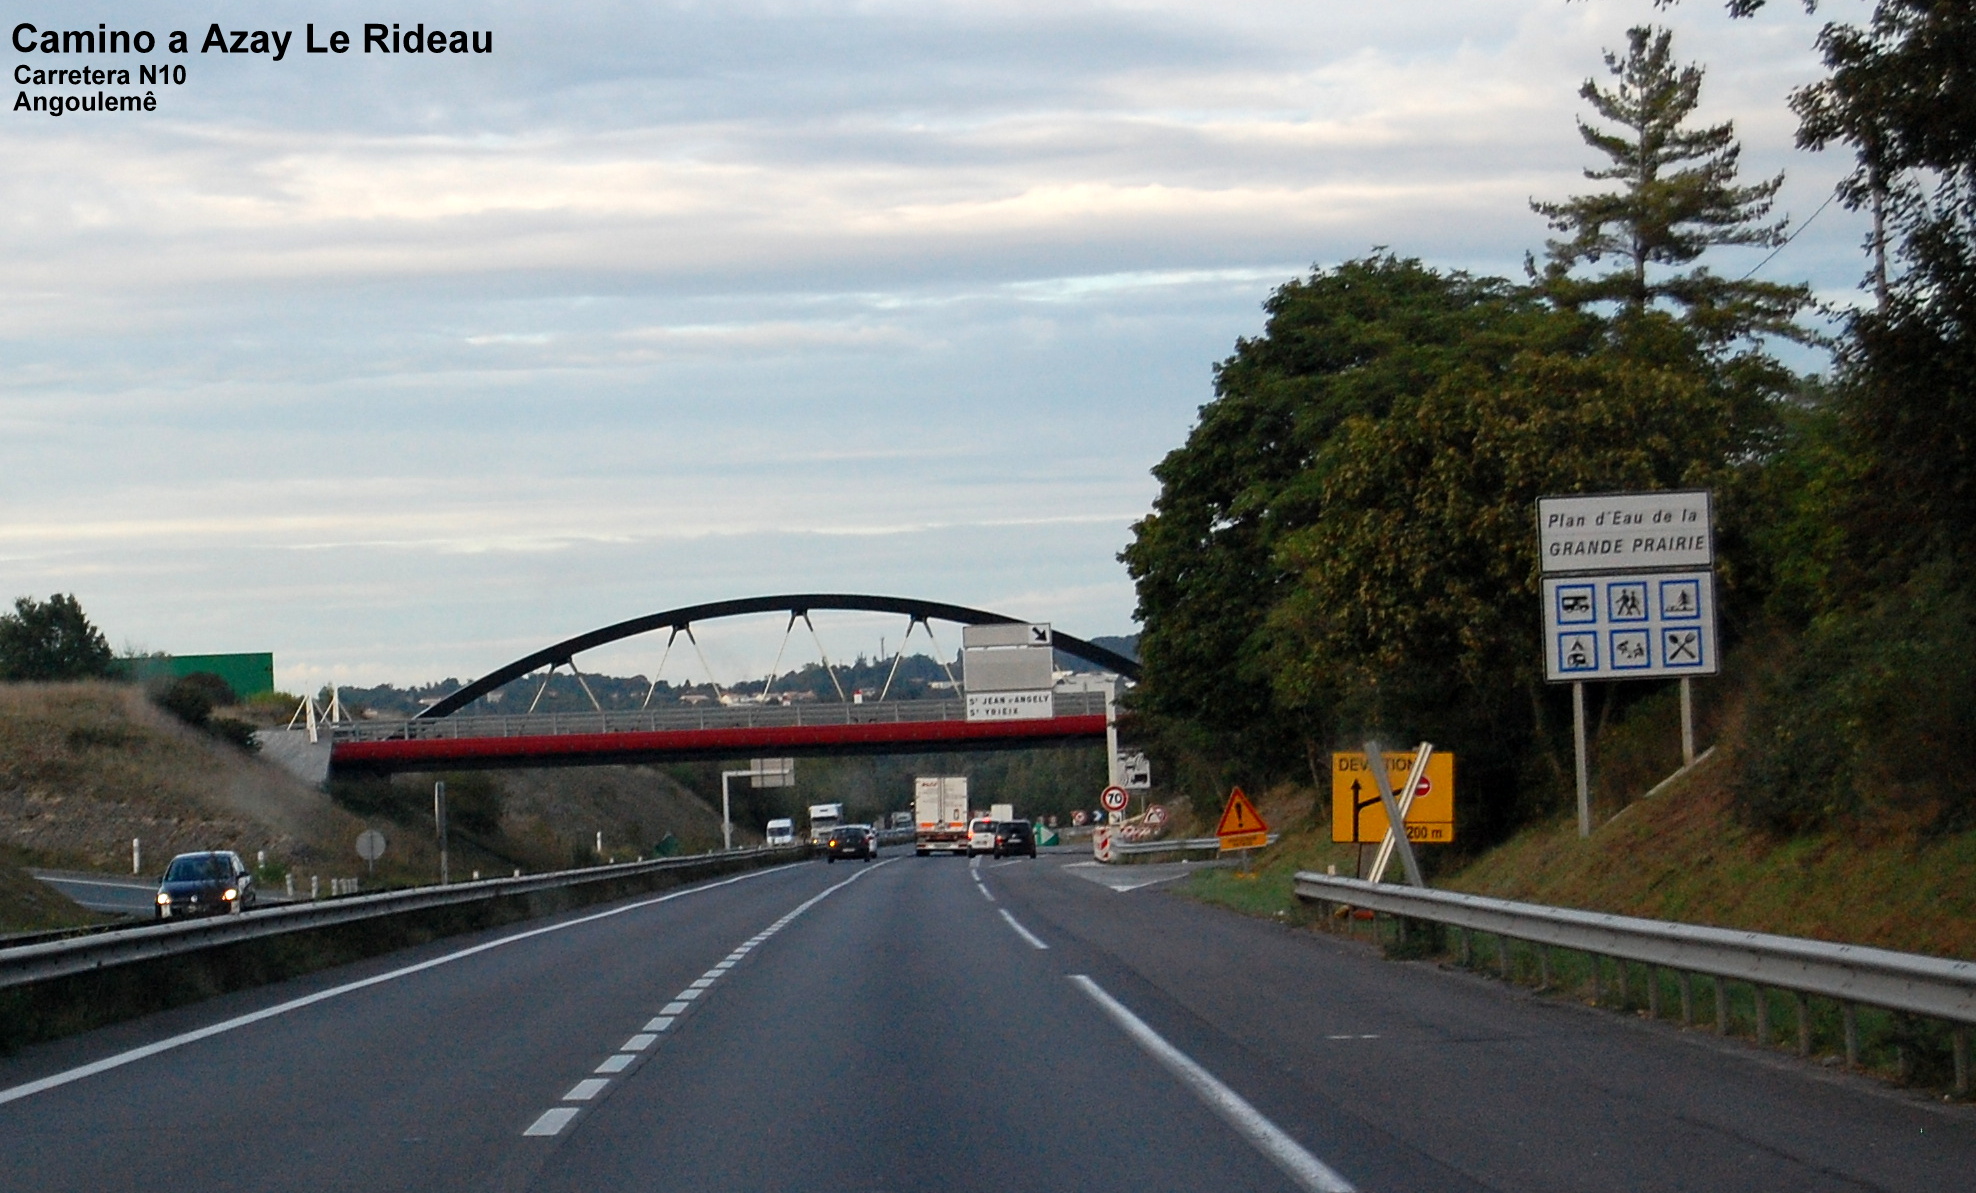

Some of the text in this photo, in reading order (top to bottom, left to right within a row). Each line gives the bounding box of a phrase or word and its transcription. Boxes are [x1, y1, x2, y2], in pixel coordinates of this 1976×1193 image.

[1549, 509, 1697, 528] Plan d'Eau de la
[1550, 535, 1704, 556] GRANDE PRAIRIE
[983, 697, 1006, 705] JEAN
[1108, 793, 1122, 804] 70
[1406, 825, 1443, 839] 200 m
